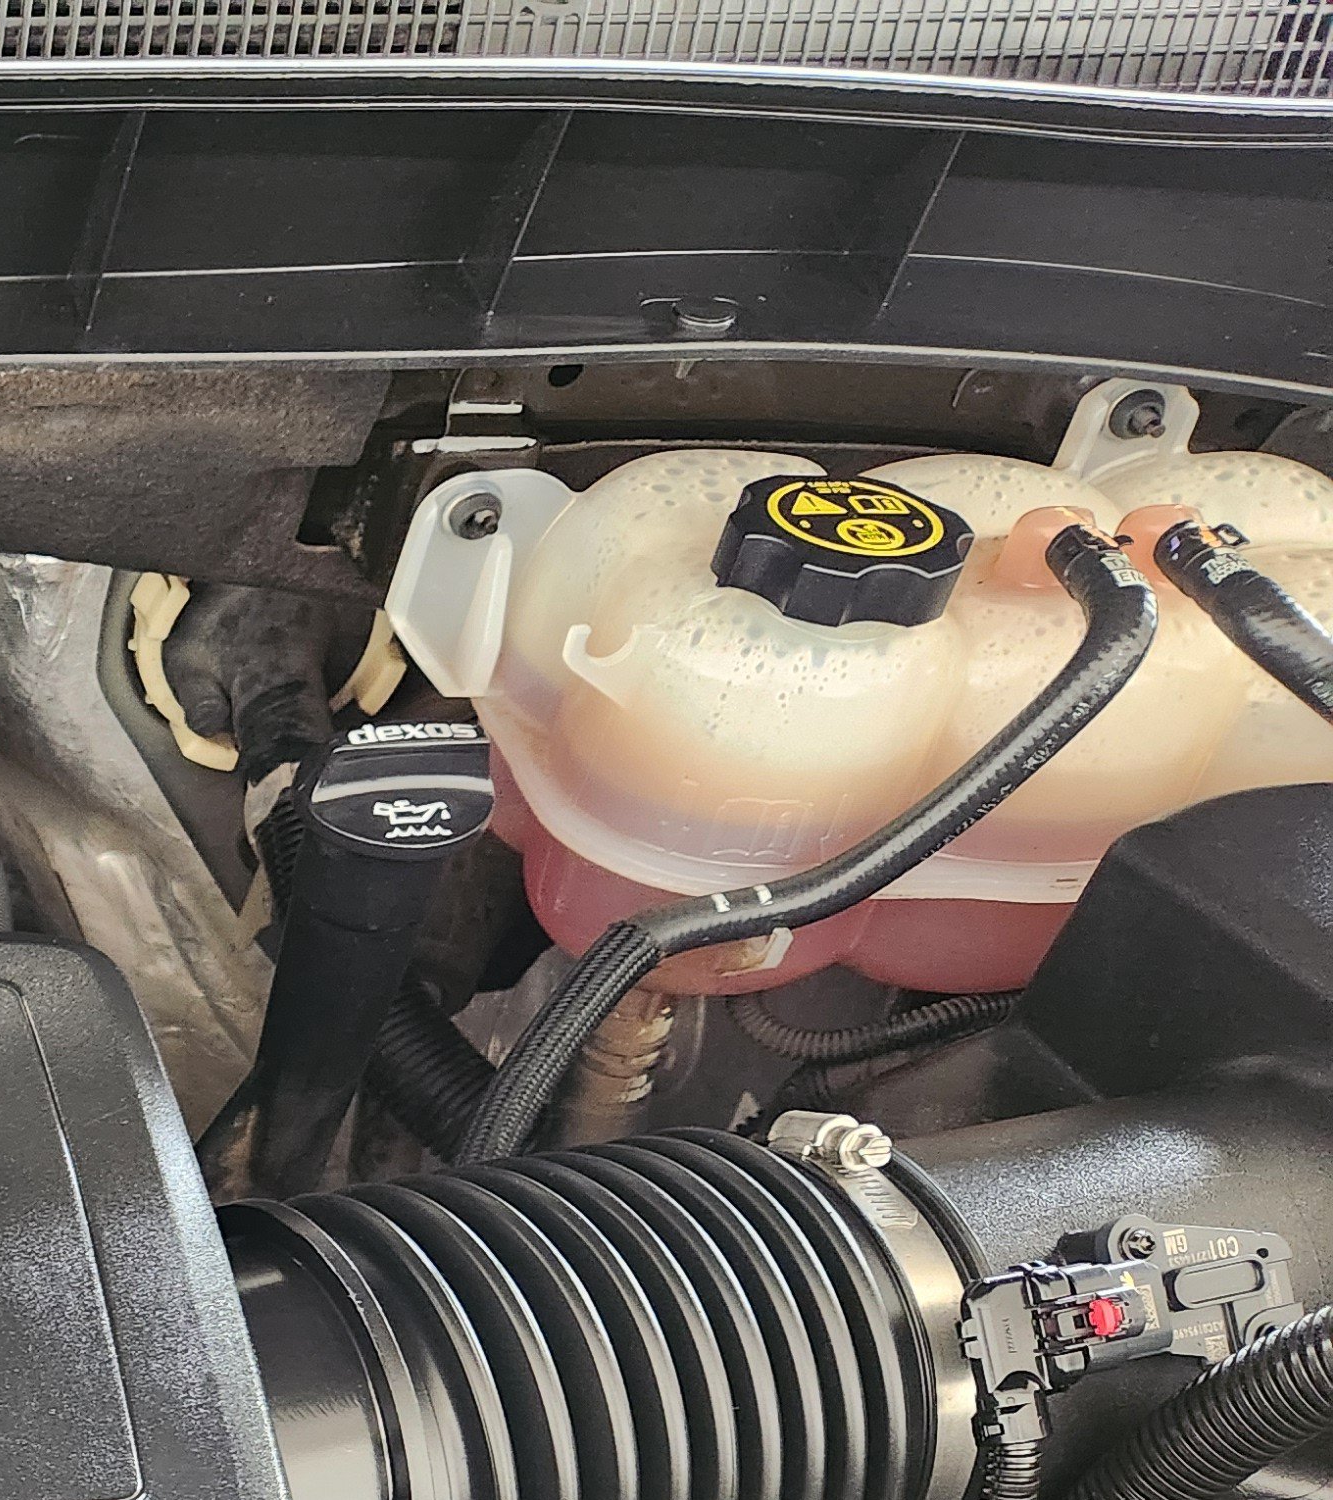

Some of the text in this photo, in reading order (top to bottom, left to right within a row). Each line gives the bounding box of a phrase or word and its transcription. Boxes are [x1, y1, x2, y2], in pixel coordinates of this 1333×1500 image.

[348, 723, 477, 745] dexos
[1164, 1233, 1188, 1256] GM
[1209, 1236, 1239, 1260] C01
